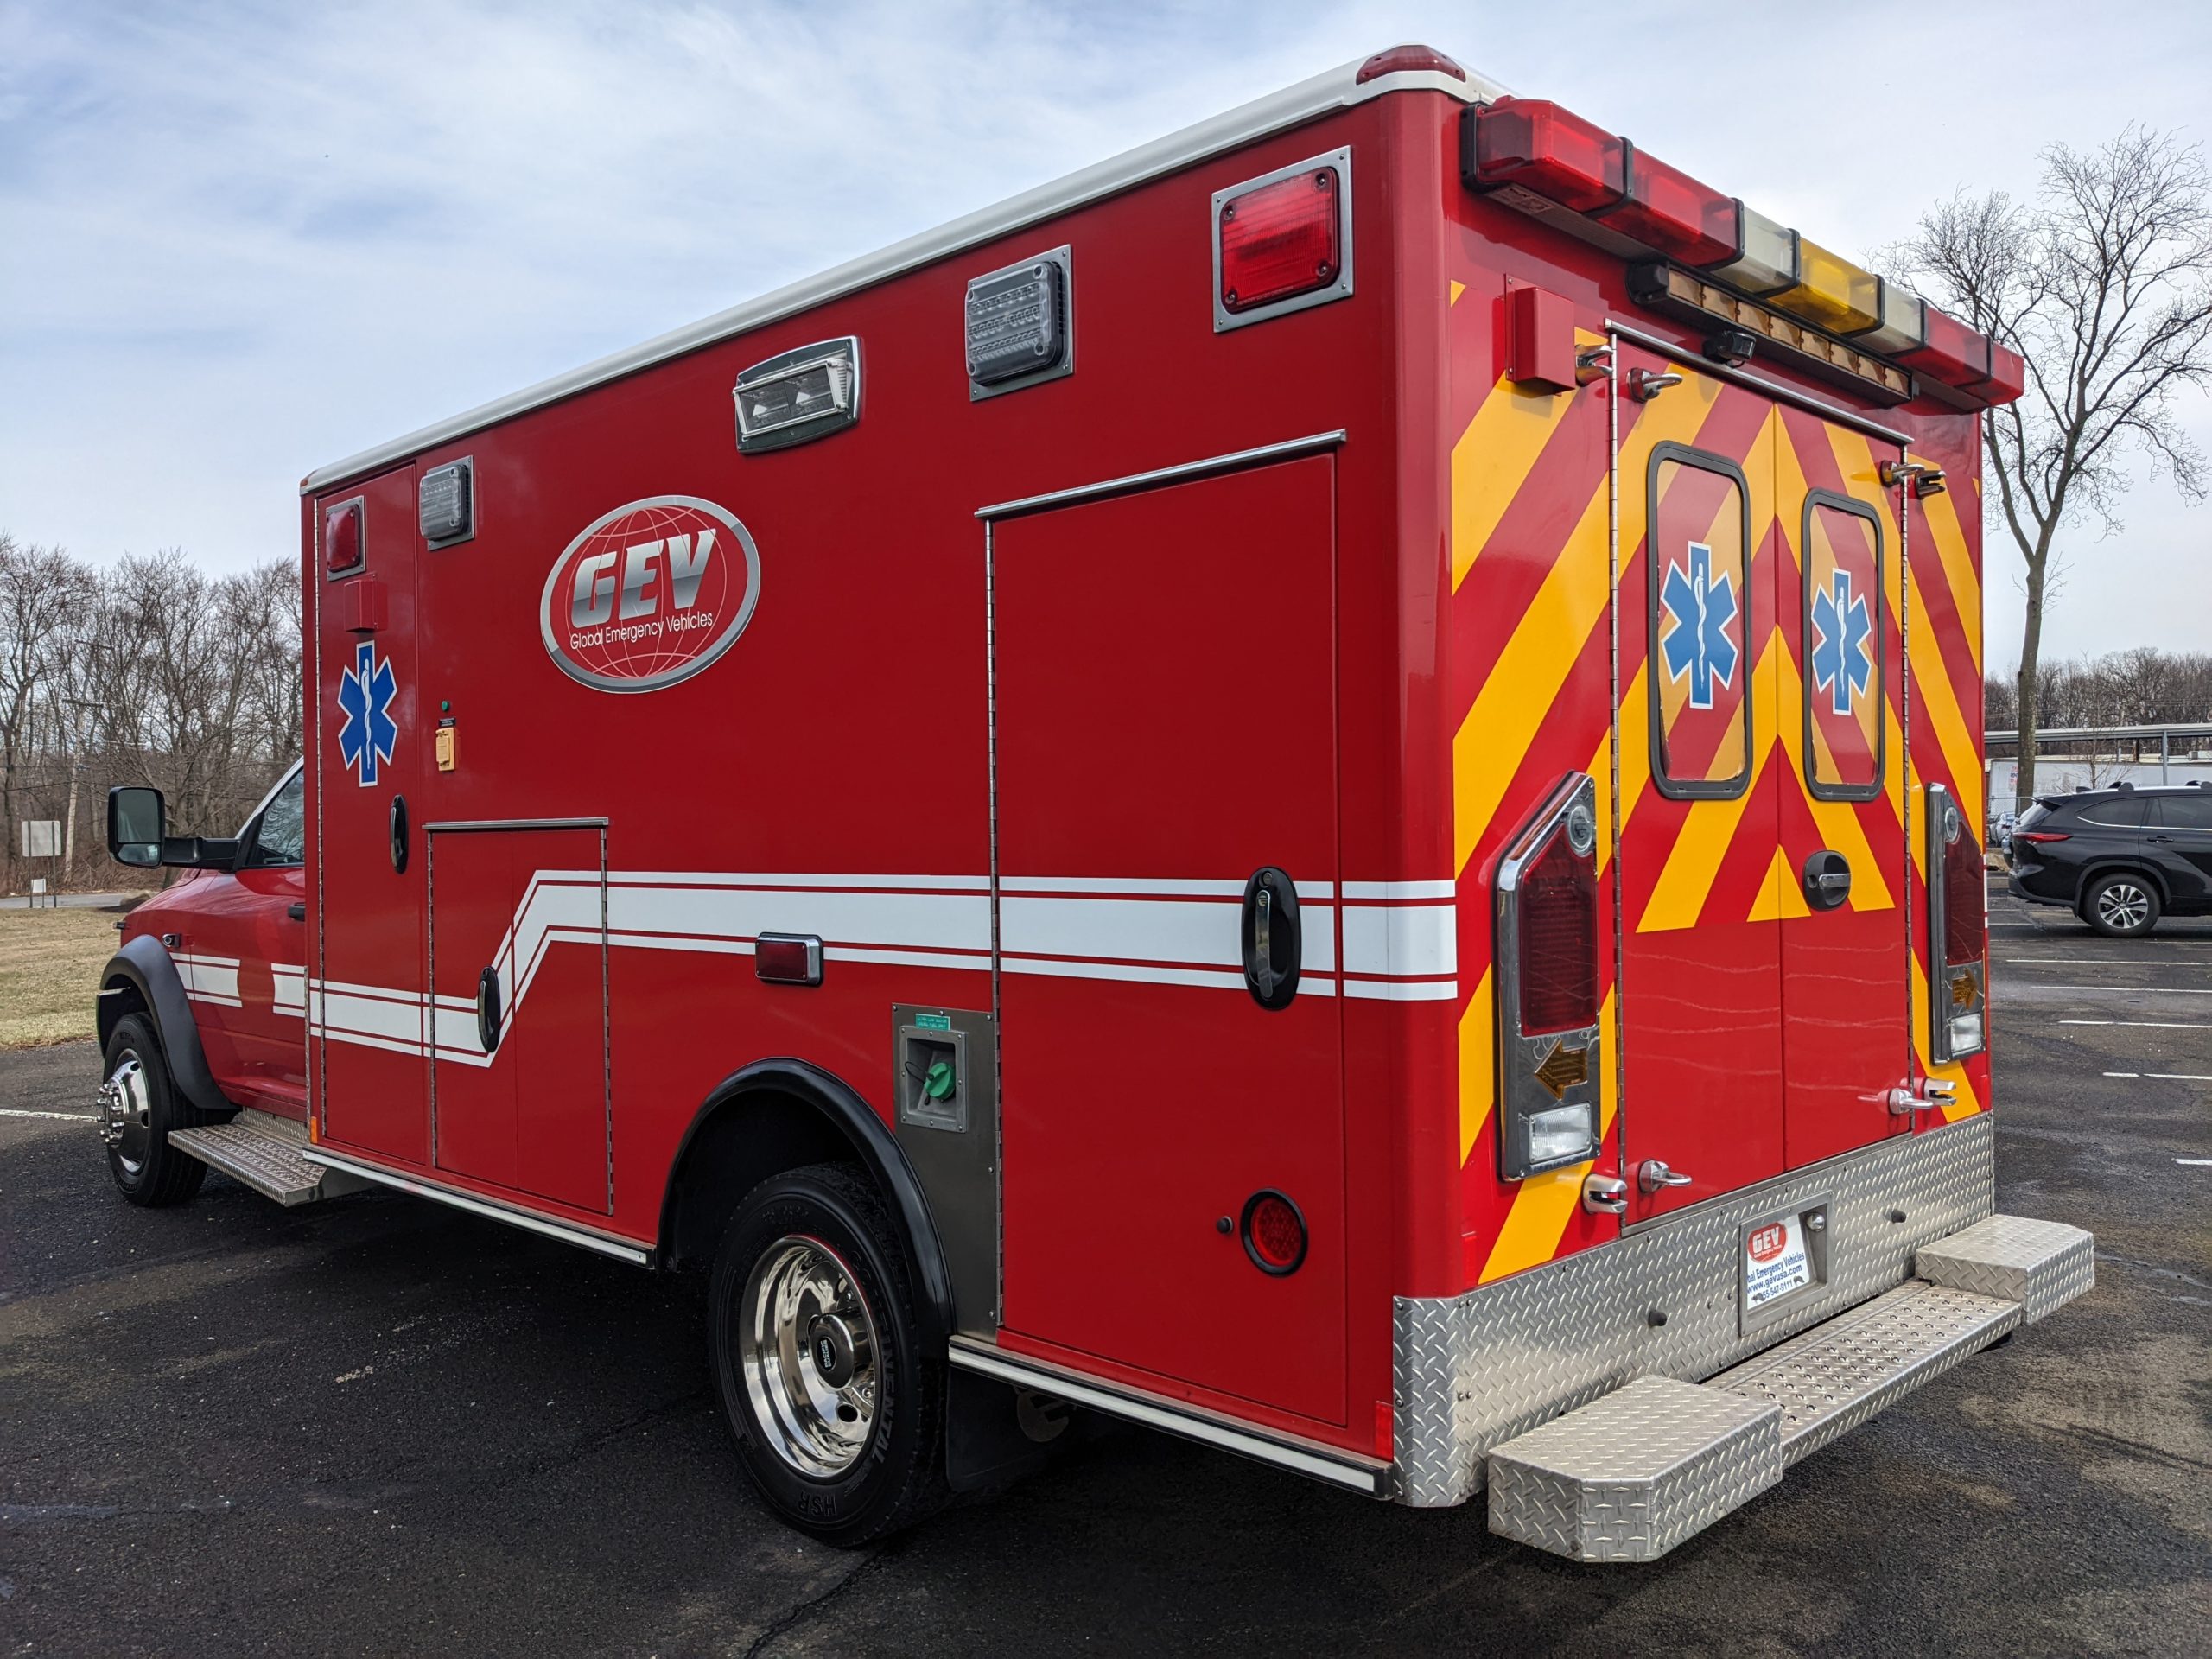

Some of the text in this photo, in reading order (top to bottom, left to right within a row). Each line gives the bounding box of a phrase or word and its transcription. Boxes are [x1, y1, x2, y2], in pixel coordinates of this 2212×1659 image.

[571, 528, 716, 628] GEV
[570, 611, 713, 650] Global Emergency Vehicles
[1752, 1226, 1780, 1254] GEV
[1747, 1264, 1802, 1294] www.gevusa.com
[1756, 1261, 1783, 1279] Emergency
[1783, 1252, 1805, 1268] Vehicles
[1761, 1279, 1793, 1299] 55-547-9111
[798, 1490, 837, 1517] HSR
